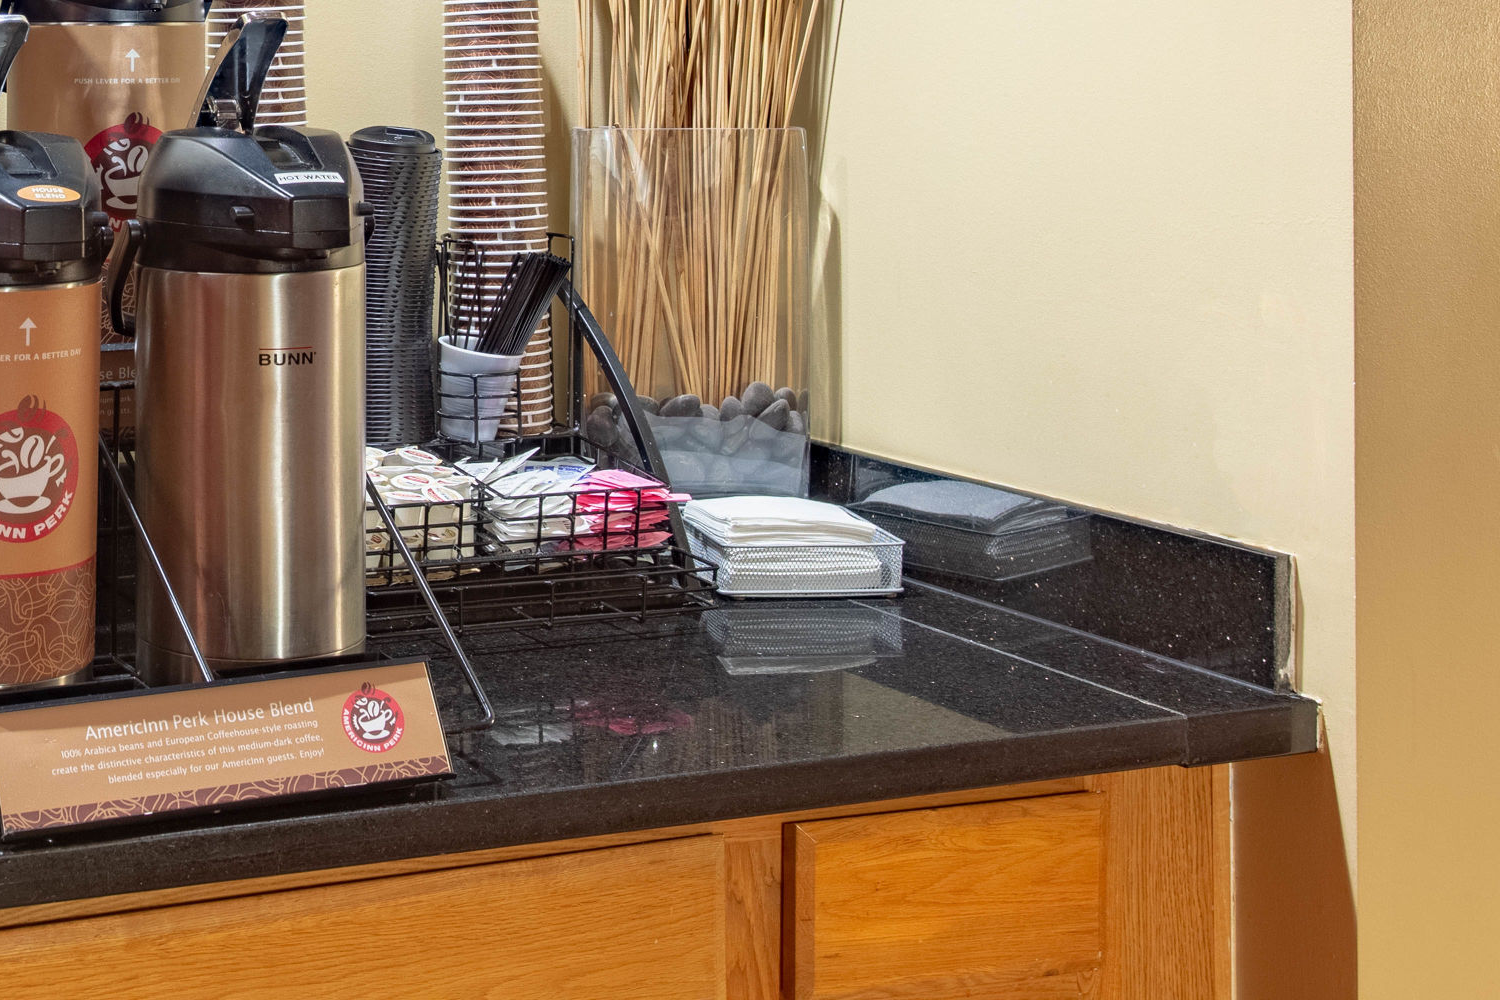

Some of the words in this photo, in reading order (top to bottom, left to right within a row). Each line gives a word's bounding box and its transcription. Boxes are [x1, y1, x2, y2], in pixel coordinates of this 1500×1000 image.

[120, 77, 136, 85] FOR
[14, 353, 31, 362] FOR
[34, 353, 40, 361] A
[42, 350, 69, 360] BETTER
[69, 348, 82, 357] DAY
[258, 352, 315, 366] BUNN
[33, 490, 74, 537] PERK
[85, 718, 169, 741] AmericInn
[172, 711, 210, 730] Perk
[214, 707, 265, 725] House
[270, 697, 315, 718] Blend
[342, 708, 381, 752] AMERICINN
[383, 727, 403, 750] PERK
[51, 766, 78, 776] create
[81, 762, 95, 772] the
[97, 756, 142, 770] distinctive
[144, 748, 206, 765] characteristics
[207, 746, 217, 756] of
[219, 744, 235, 754] this
[237, 736, 293, 752] medium-dark
[60, 749, 82, 760] 100%
[84, 745, 117, 757] Arabica
[118, 741, 145, 752] beans
[147, 738, 163, 748] and
[165, 734, 205, 746] European
[206, 723, 282, 741] Coffeehouse-style
[283, 719, 319, 730] roasting
[107, 771, 143, 784] blended
[145, 766, 188, 780] especially
[189, 764, 203, 774] for
[204, 763, 219, 772] our
[221, 756, 265, 769] AmericInn
[266, 752, 297, 764] guests.
[299, 747, 325, 760] Enjoy!
